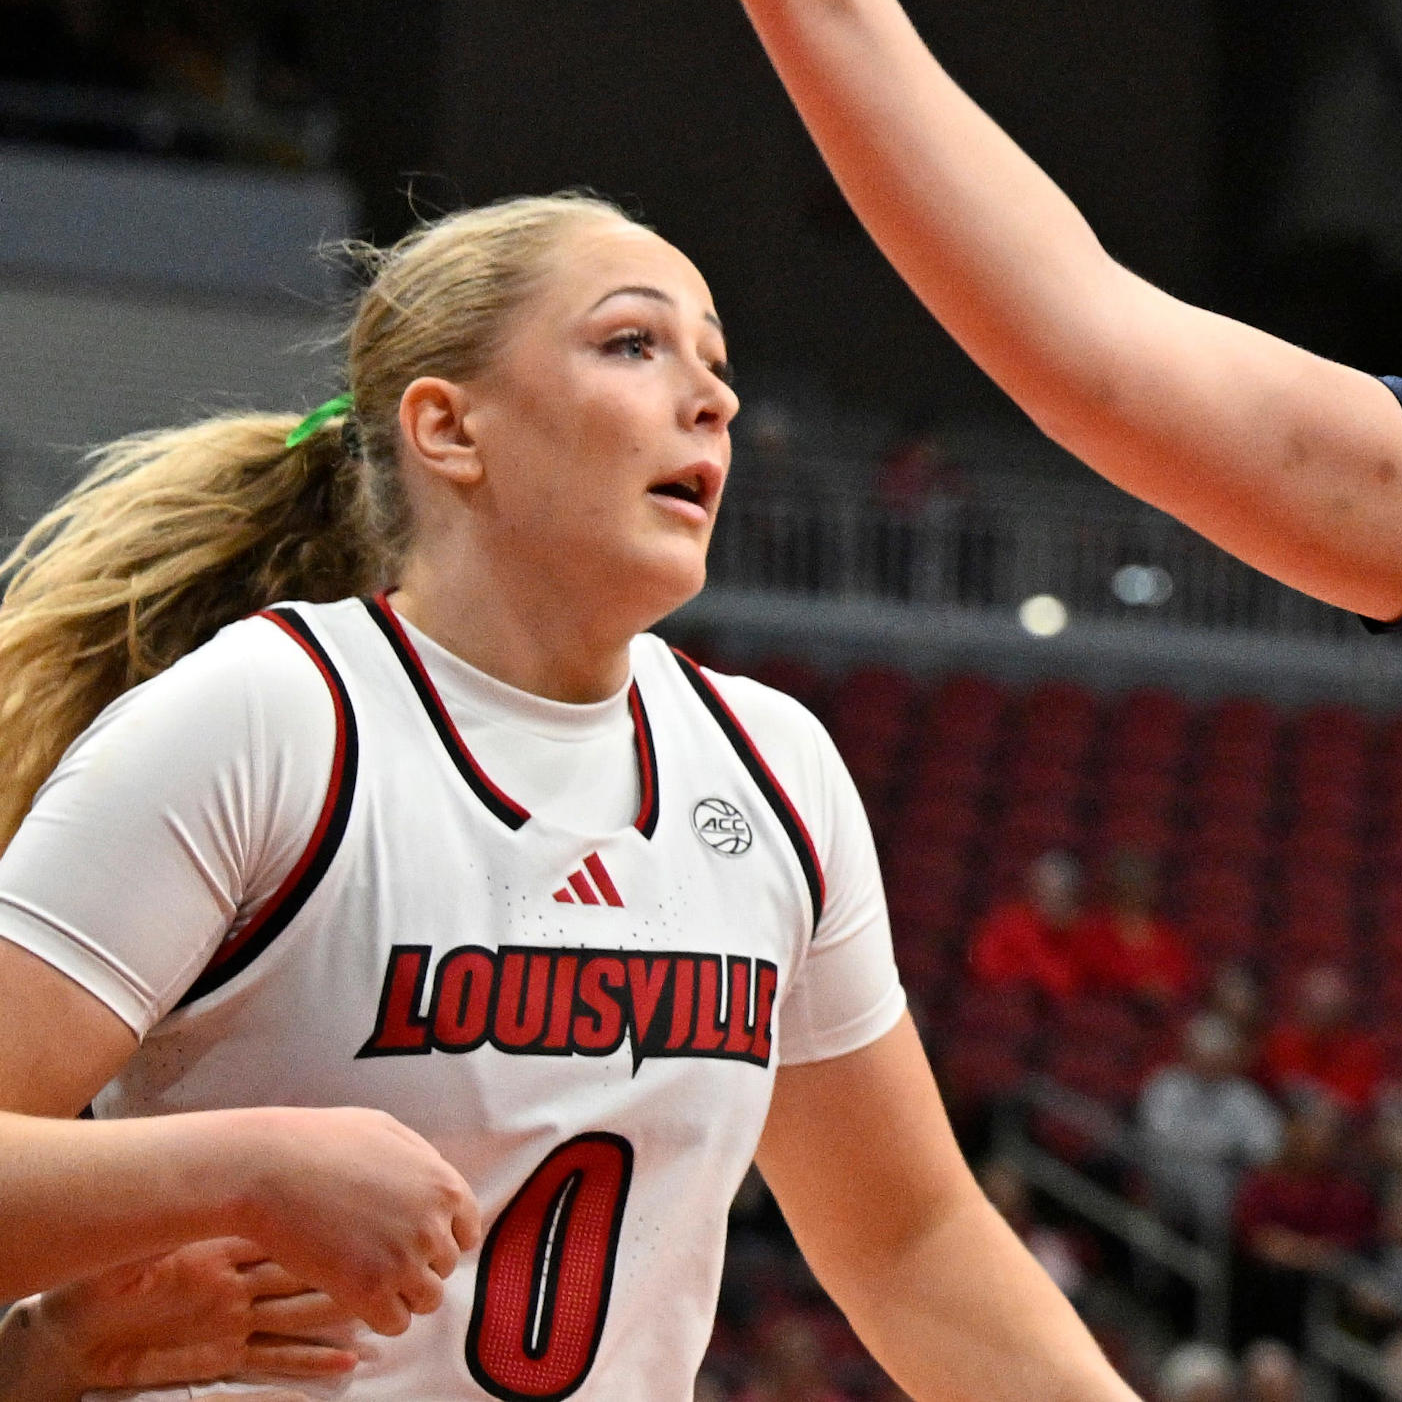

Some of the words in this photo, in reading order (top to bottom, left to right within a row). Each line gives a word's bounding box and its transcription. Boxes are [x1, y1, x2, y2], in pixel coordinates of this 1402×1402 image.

[701, 817, 746, 832] ACC
[354, 944, 779, 1079] LOUISVILLE
[465, 1131, 634, 1402] 0
